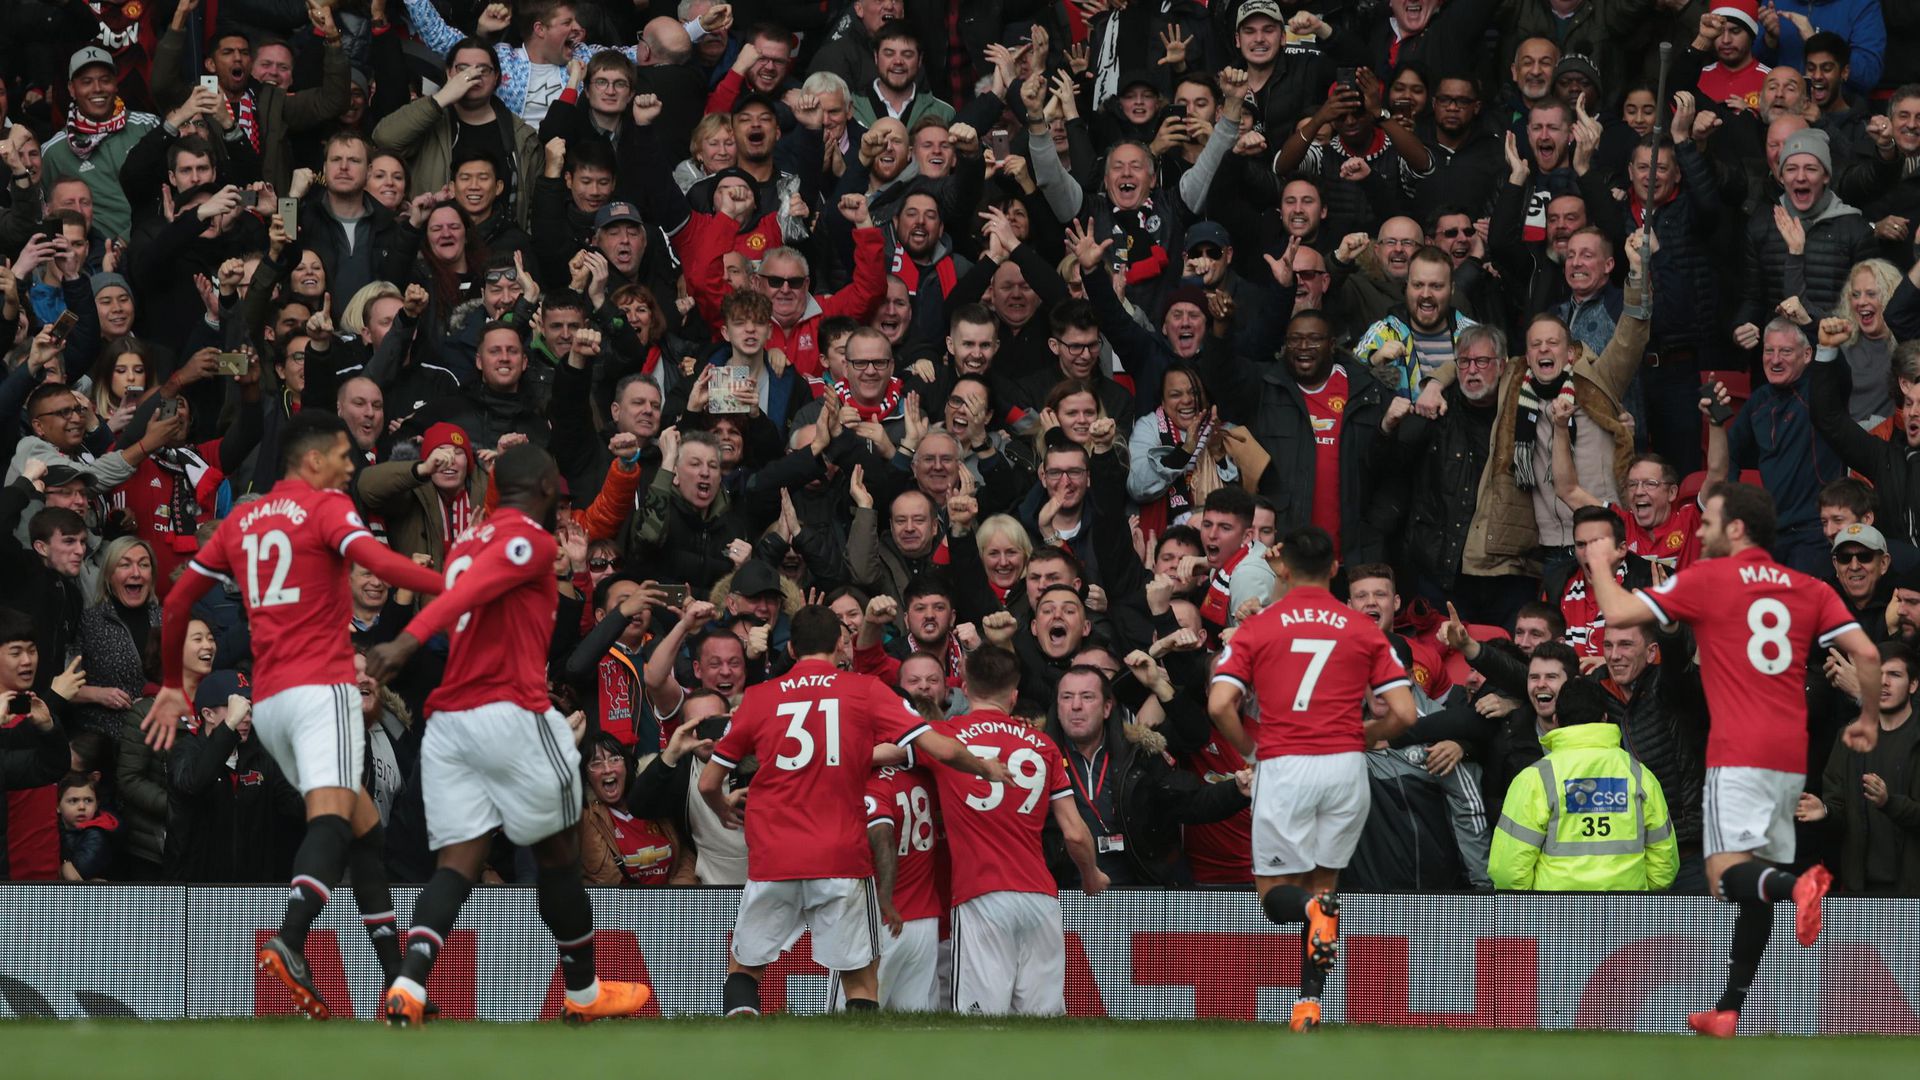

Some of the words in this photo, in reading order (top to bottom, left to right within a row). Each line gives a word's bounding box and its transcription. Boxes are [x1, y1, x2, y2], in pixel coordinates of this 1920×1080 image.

[239, 498, 308, 533] SMALLING
[241, 529, 301, 608] 12
[1738, 564, 1792, 588] MATA
[1279, 607, 1348, 630] ALEXIS
[1746, 597, 1793, 676] 8
[1290, 638, 1337, 712] 7
[775, 698, 841, 771] 31
[955, 722, 1046, 749] McTOMINAY
[966, 744, 1047, 814] 39
[1591, 791, 1627, 806] CSG
[895, 785, 934, 856] 18
[1582, 816, 1611, 837] 35
